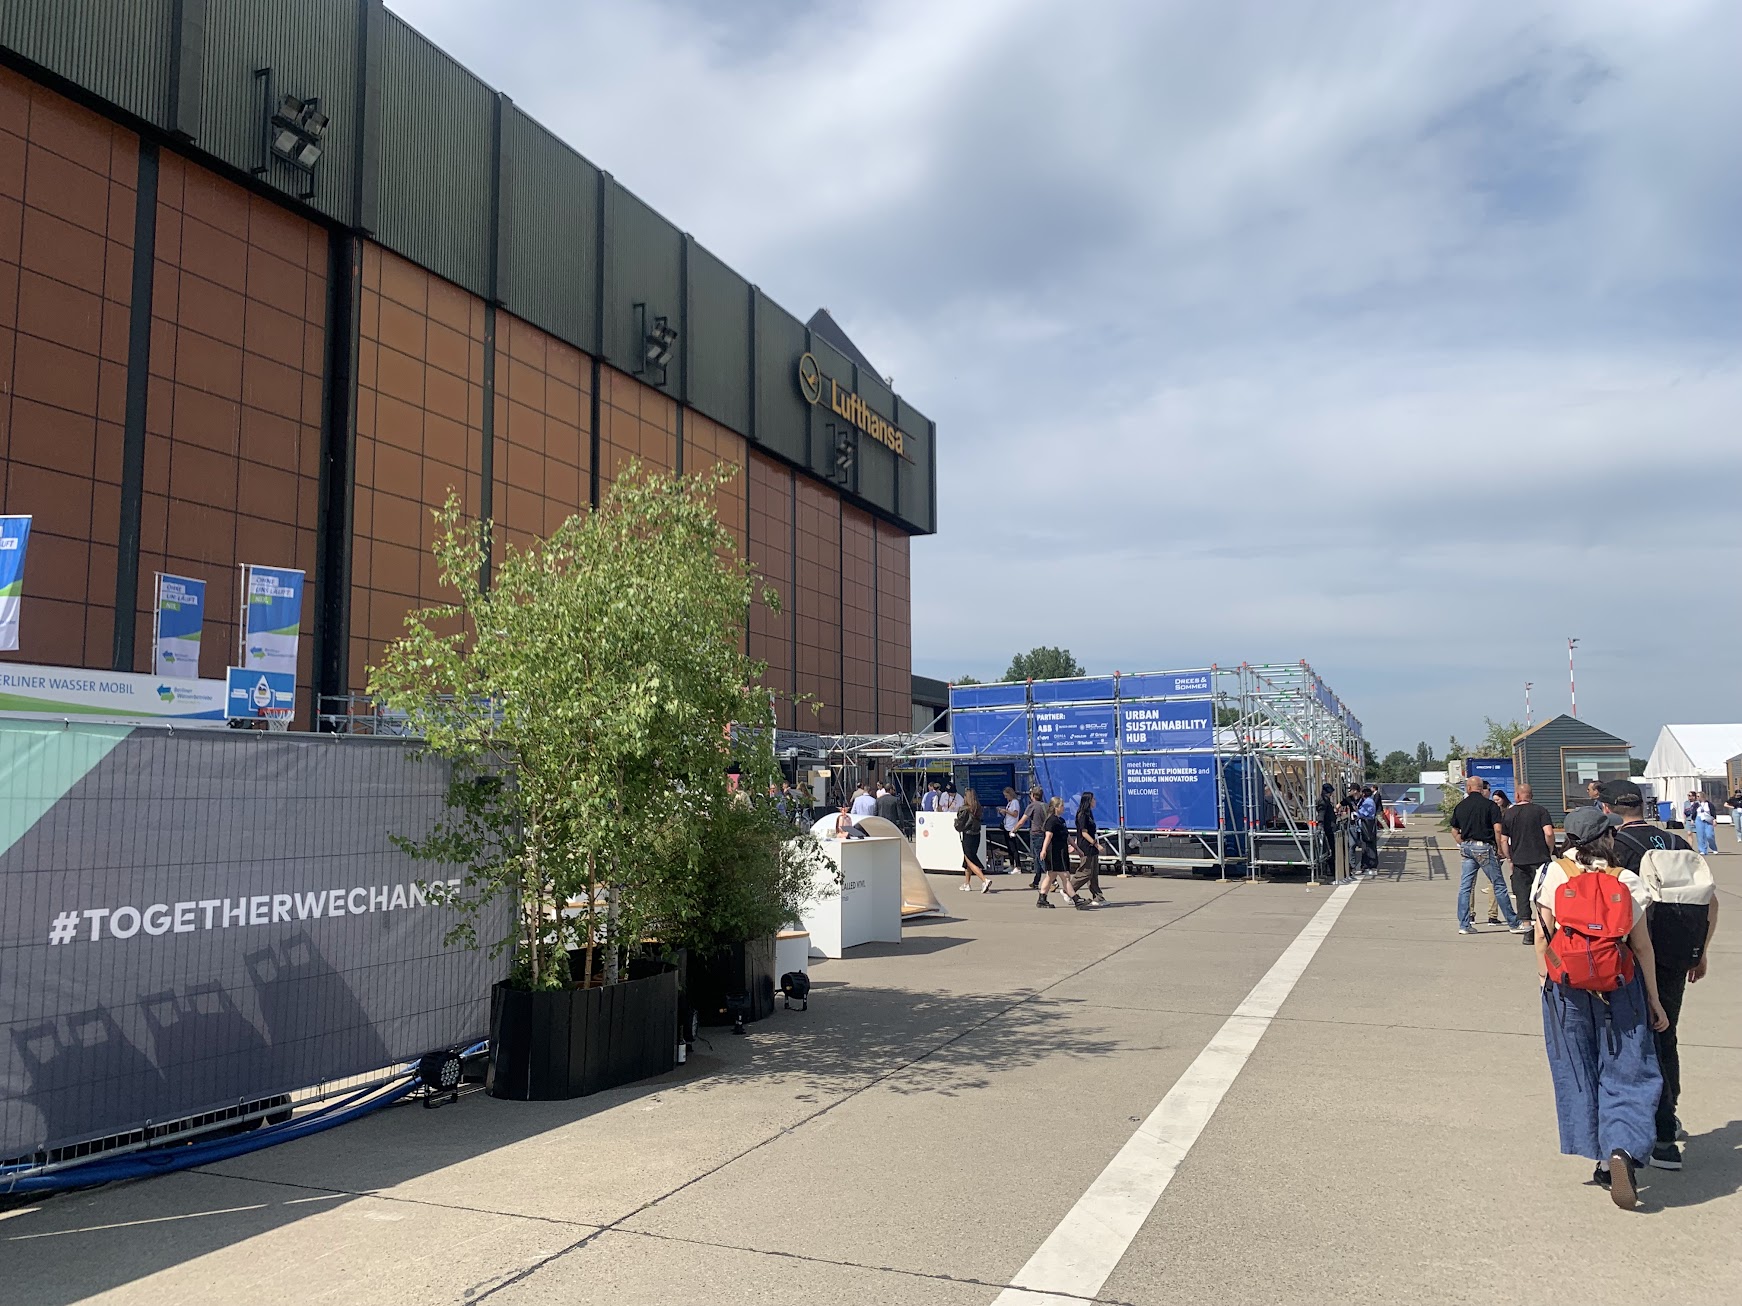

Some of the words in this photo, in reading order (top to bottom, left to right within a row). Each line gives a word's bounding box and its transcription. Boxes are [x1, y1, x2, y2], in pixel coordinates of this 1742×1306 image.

[832, 378, 903, 456] Lufthansa
[49, 678, 95, 692] WASSER
[99, 682, 135, 695] MOBIL
[1036, 713, 1066, 721] PARTNER:
[1125, 710, 1159, 720] URBAN
[1037, 724, 1052, 732] ABB
[1125, 719, 1207, 731] SUSTAINABILITY
[1126, 733, 1147, 743] HUB
